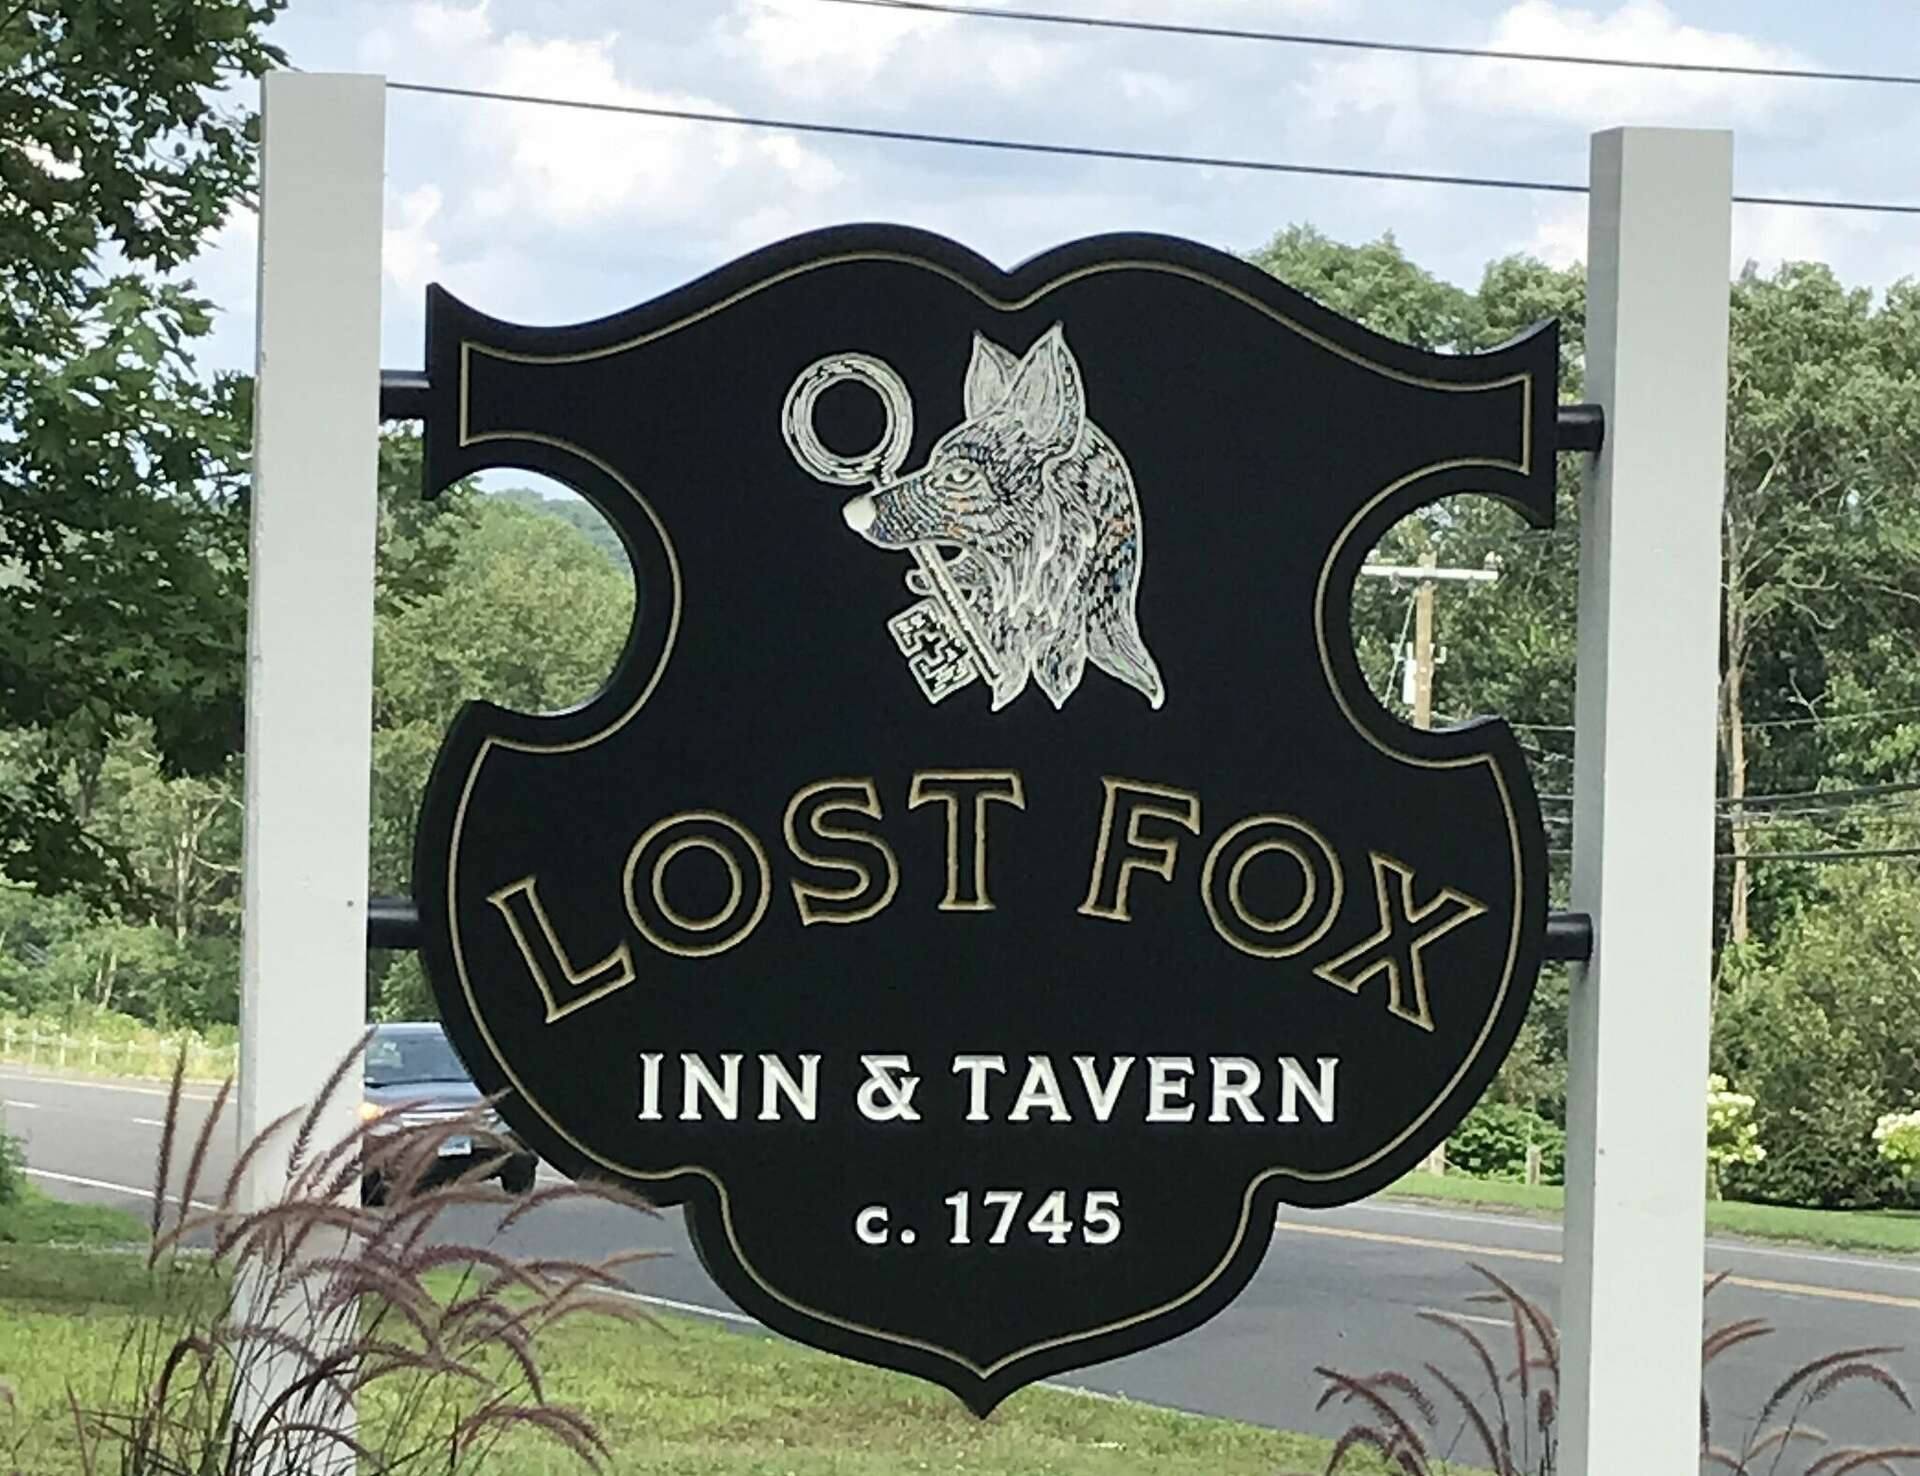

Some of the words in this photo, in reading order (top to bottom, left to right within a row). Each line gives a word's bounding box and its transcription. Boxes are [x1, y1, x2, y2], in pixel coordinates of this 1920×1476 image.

[486, 769, 1026, 1024] LOST
[1076, 775, 1489, 1032] FOX
[637, 1053, 822, 1121] INN
[856, 1054, 922, 1122] &
[951, 1055, 1340, 1123] TAVERN
[855, 1205, 916, 1245] c.
[944, 1190, 1122, 1245] 1745
